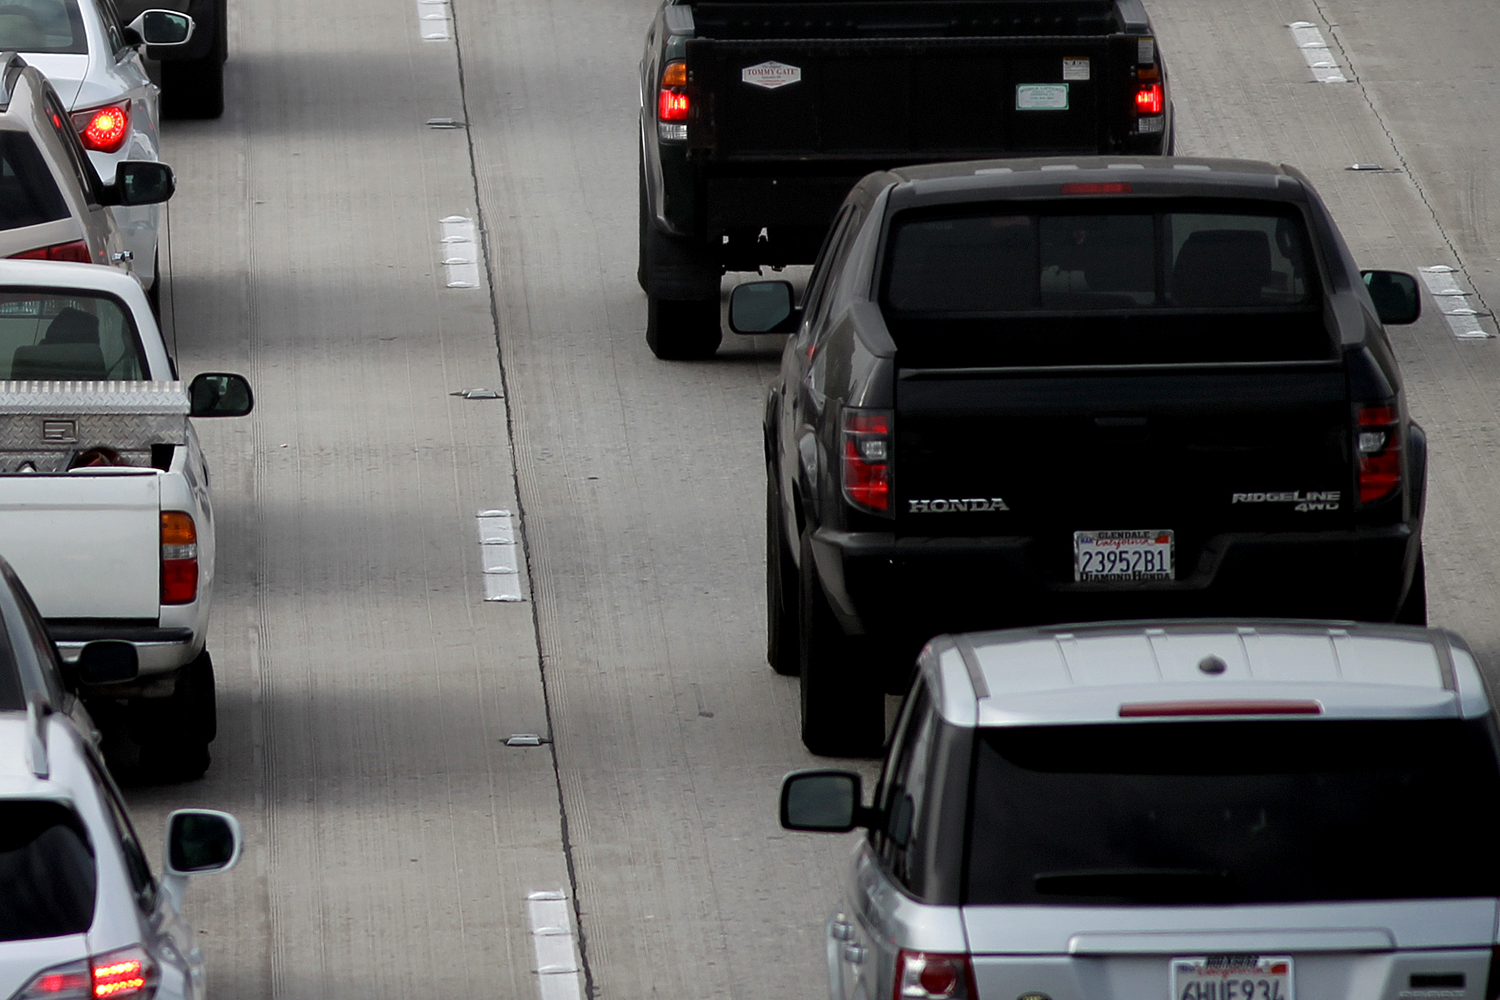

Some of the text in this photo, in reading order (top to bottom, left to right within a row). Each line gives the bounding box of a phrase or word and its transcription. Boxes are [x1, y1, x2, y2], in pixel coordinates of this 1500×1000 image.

[748, 68, 774, 76] TOMMY
[1232, 490, 1341, 504] RIDGELINE
[908, 498, 1010, 513] HONDA
[1295, 503, 1339, 512] 4WD
[1098, 531, 1150, 539] GLENDALE
[1096, 538, 1150, 549] California
[1082, 550, 1168, 573] 23952B1
